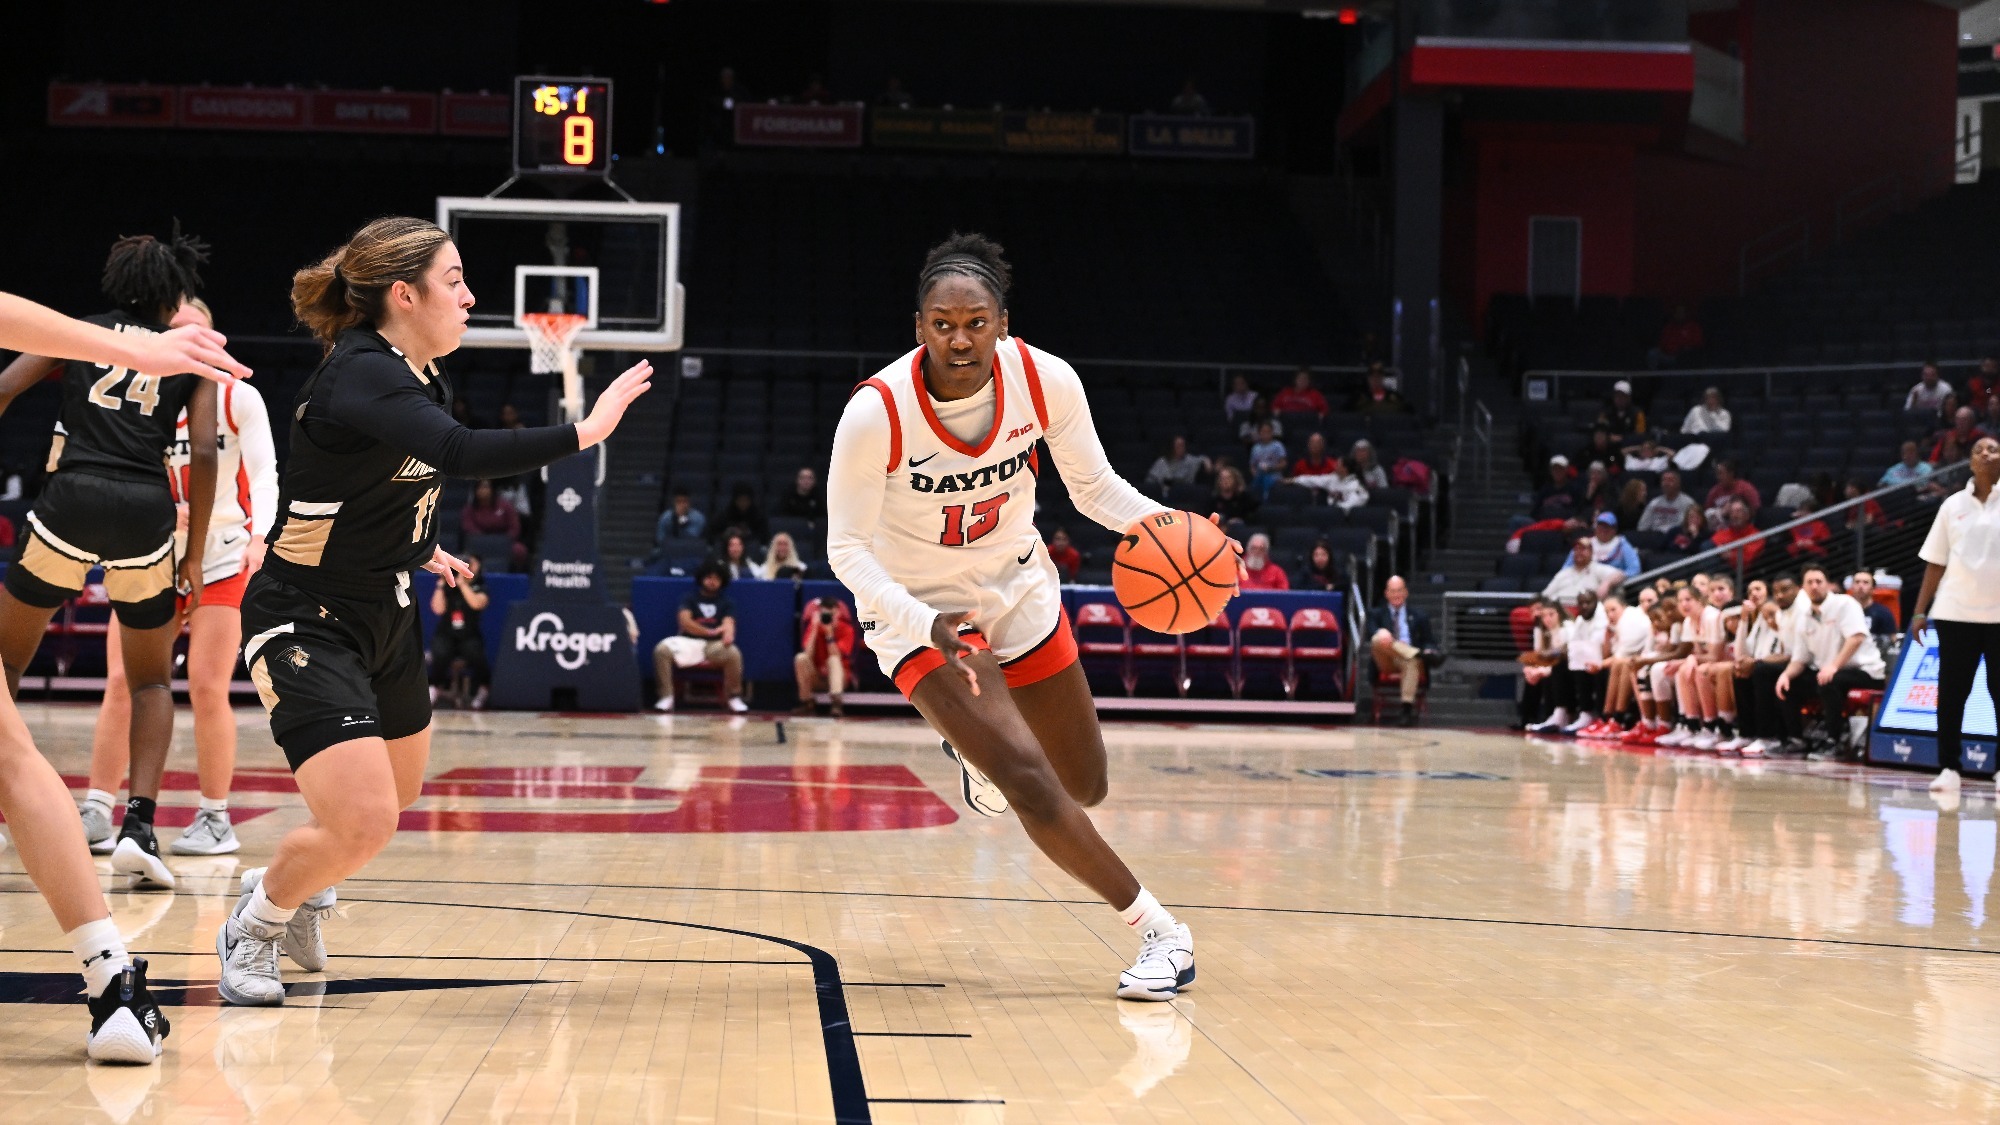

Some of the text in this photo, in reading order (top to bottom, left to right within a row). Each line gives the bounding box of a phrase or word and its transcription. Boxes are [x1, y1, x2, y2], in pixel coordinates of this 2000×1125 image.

[564, 116, 593, 164] 8
[751, 116, 845, 134] FORDHAM
[88, 362, 161, 417] 24
[910, 441, 1036, 493] DAYTON
[542, 559, 594, 574] Premier
[516, 612, 618, 670] Kroger
